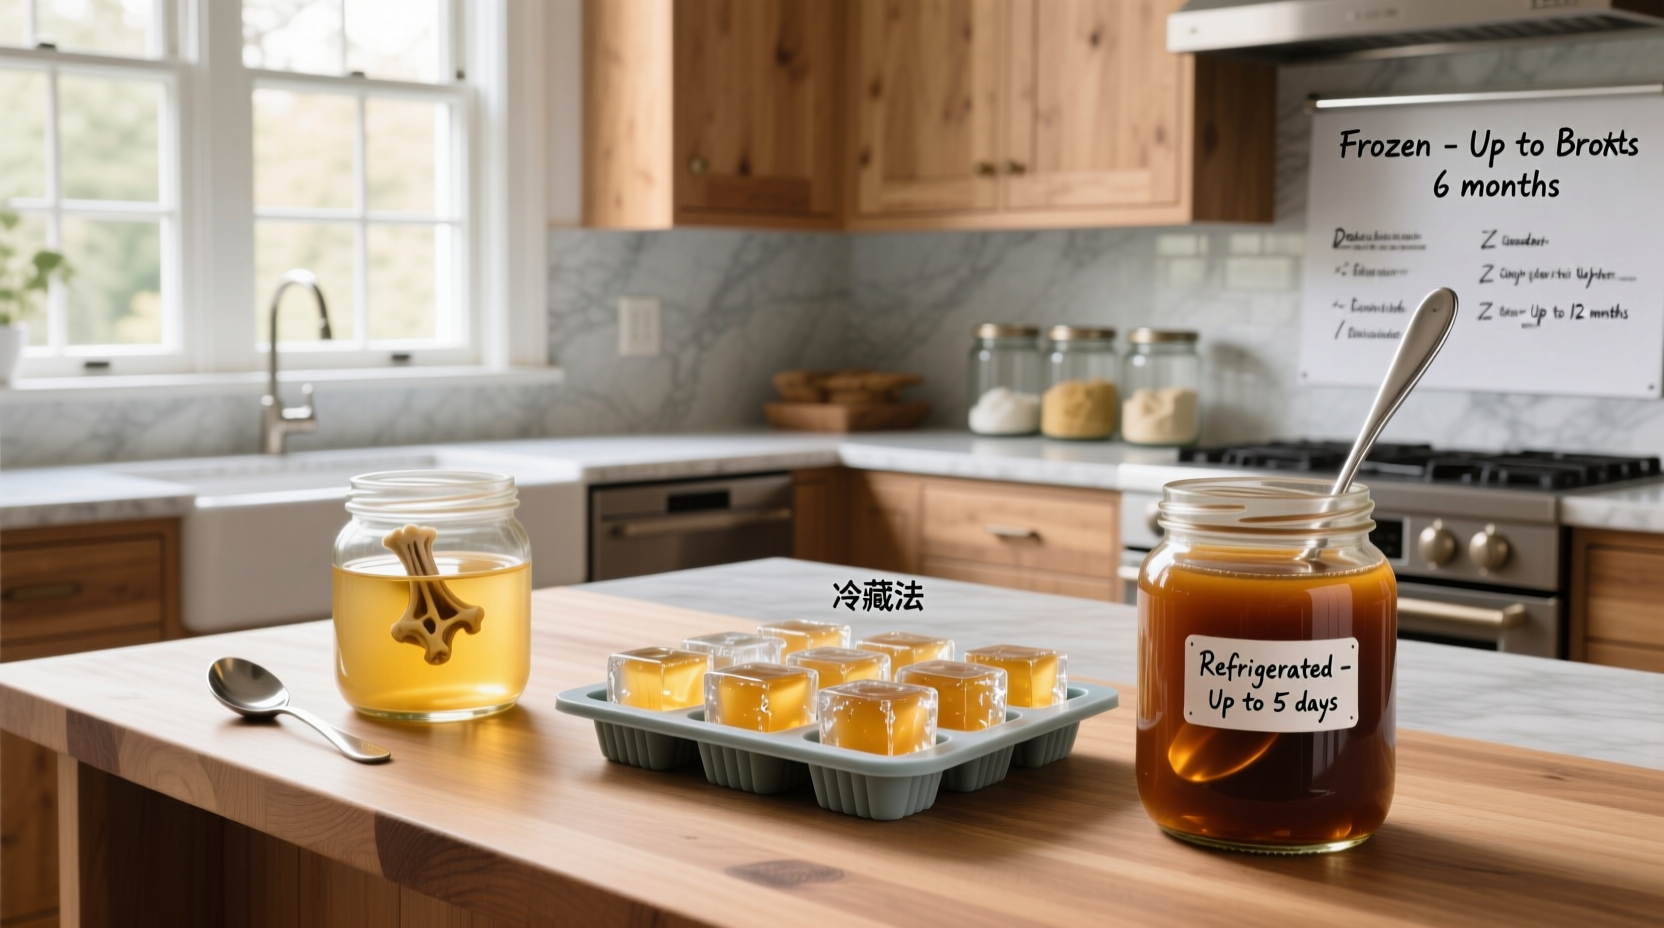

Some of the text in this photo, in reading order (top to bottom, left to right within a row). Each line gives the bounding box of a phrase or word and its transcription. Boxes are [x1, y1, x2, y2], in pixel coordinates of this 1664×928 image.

[1340, 128, 1431, 159] Frozen
[1470, 129, 1506, 168] Up
[1515, 131, 1545, 157] to
[1433, 169, 1560, 198] 6 months
[1530, 303, 1547, 326] Up
[1553, 304, 1565, 319] to
[1570, 302, 1585, 320] 12
[1199, 649, 1333, 689] Refrigerated
[1208, 688, 1338, 724] Up to 5 days
